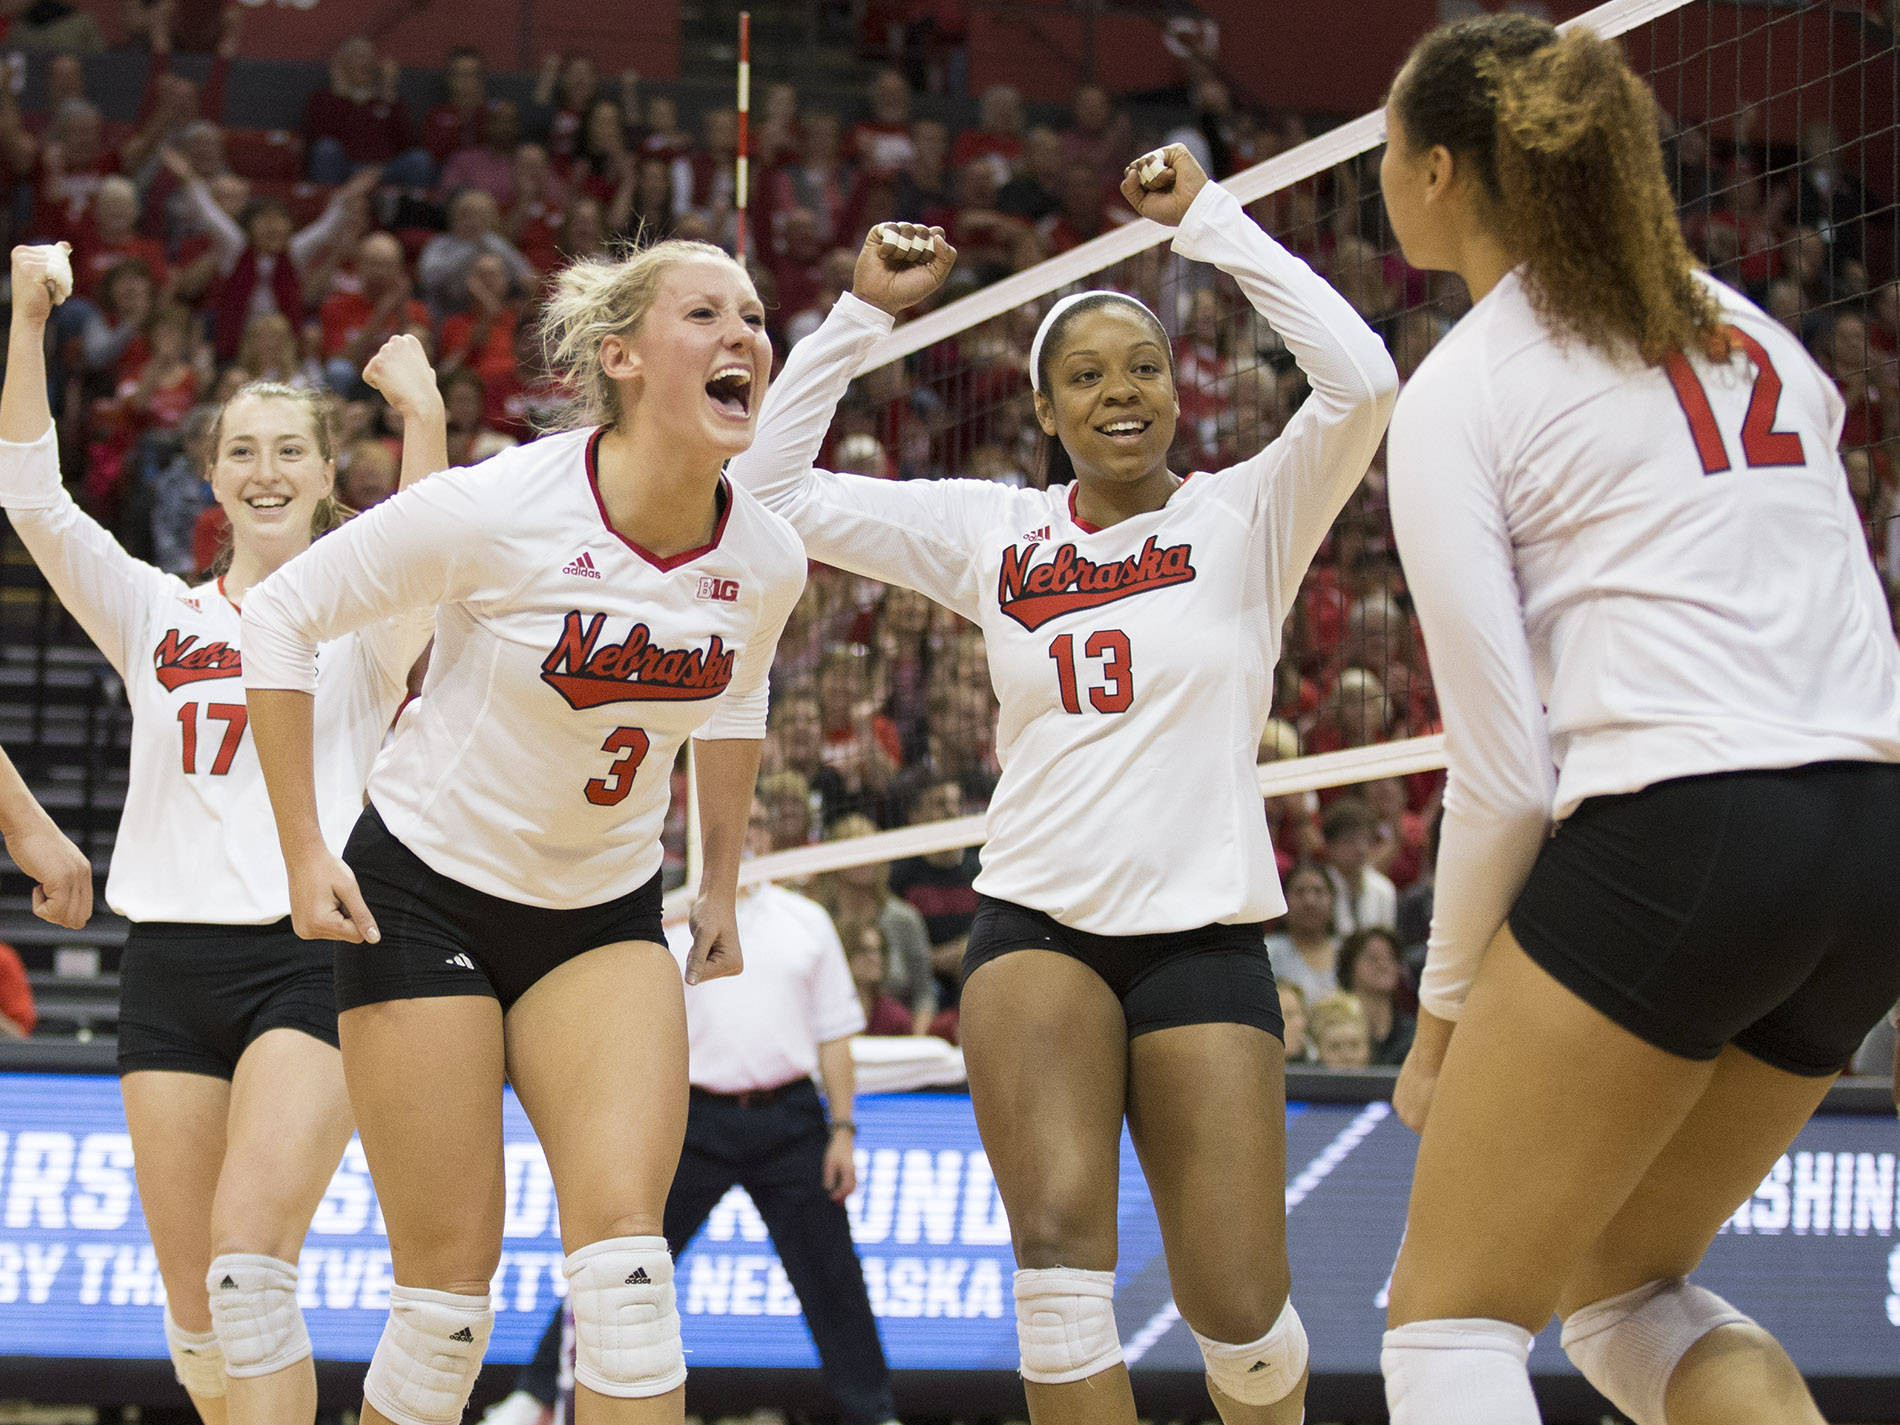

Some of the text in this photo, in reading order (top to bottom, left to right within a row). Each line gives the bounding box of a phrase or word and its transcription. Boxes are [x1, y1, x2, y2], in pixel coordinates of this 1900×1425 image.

[1660, 324, 1806, 475] 12
[562, 566, 601, 579] adidas
[998, 535, 1193, 607] Nebraska
[154, 628, 242, 673] Nebr
[541, 610, 735, 690] Nebraska
[1049, 629, 1134, 714] 13
[177, 702, 248, 776] 17
[584, 726, 650, 806] 3
